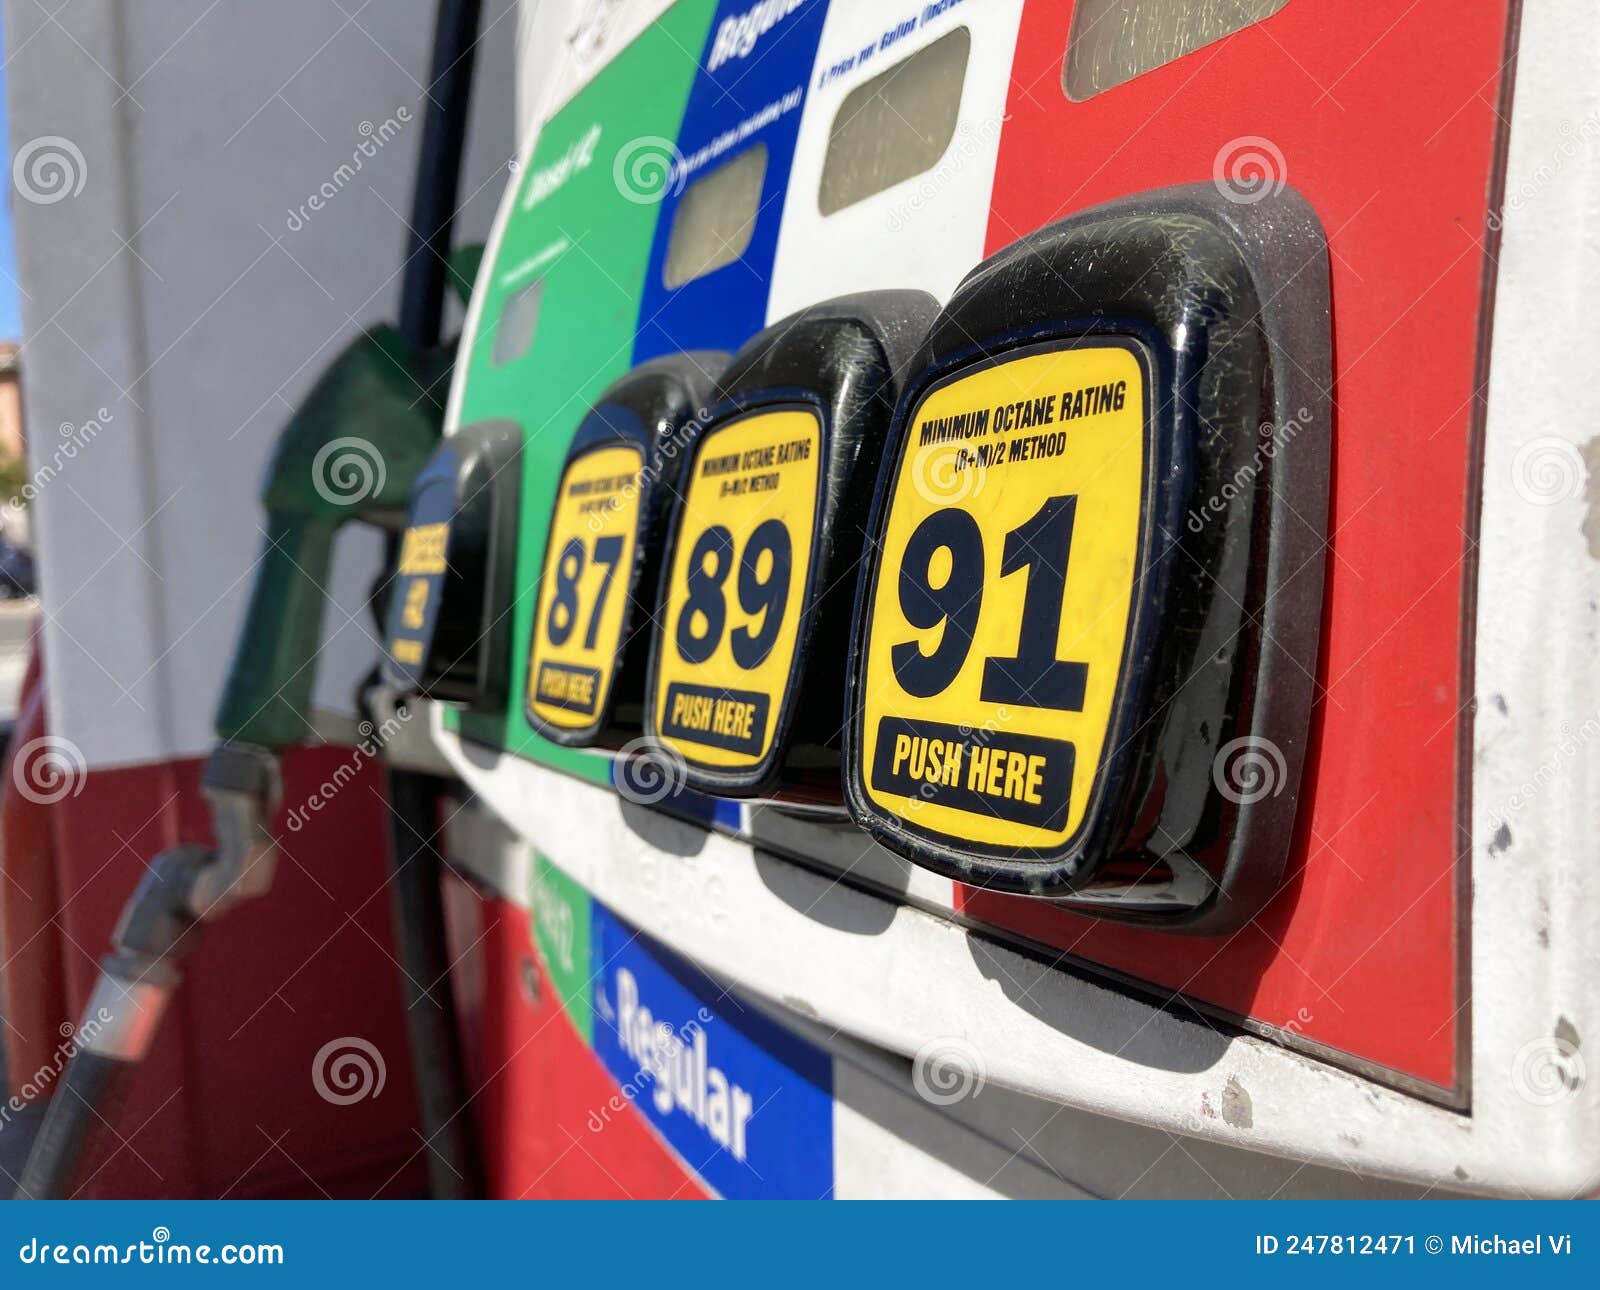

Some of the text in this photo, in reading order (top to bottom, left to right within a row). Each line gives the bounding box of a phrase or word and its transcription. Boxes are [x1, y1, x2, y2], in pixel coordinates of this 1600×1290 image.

[919, 381, 1126, 447] MINIMUM OCTANE RATING
[776, 438, 811, 465] RATING
[955, 431, 1067, 473] (R+M)/2 METHOD
[547, 535, 626, 650] 87
[675, 519, 792, 671] 89
[891, 495, 1090, 712] 91
[671, 693, 754, 739] PUSH HERE
[892, 734, 1046, 805] PUSH HERE
[617, 966, 752, 1162] Regular
